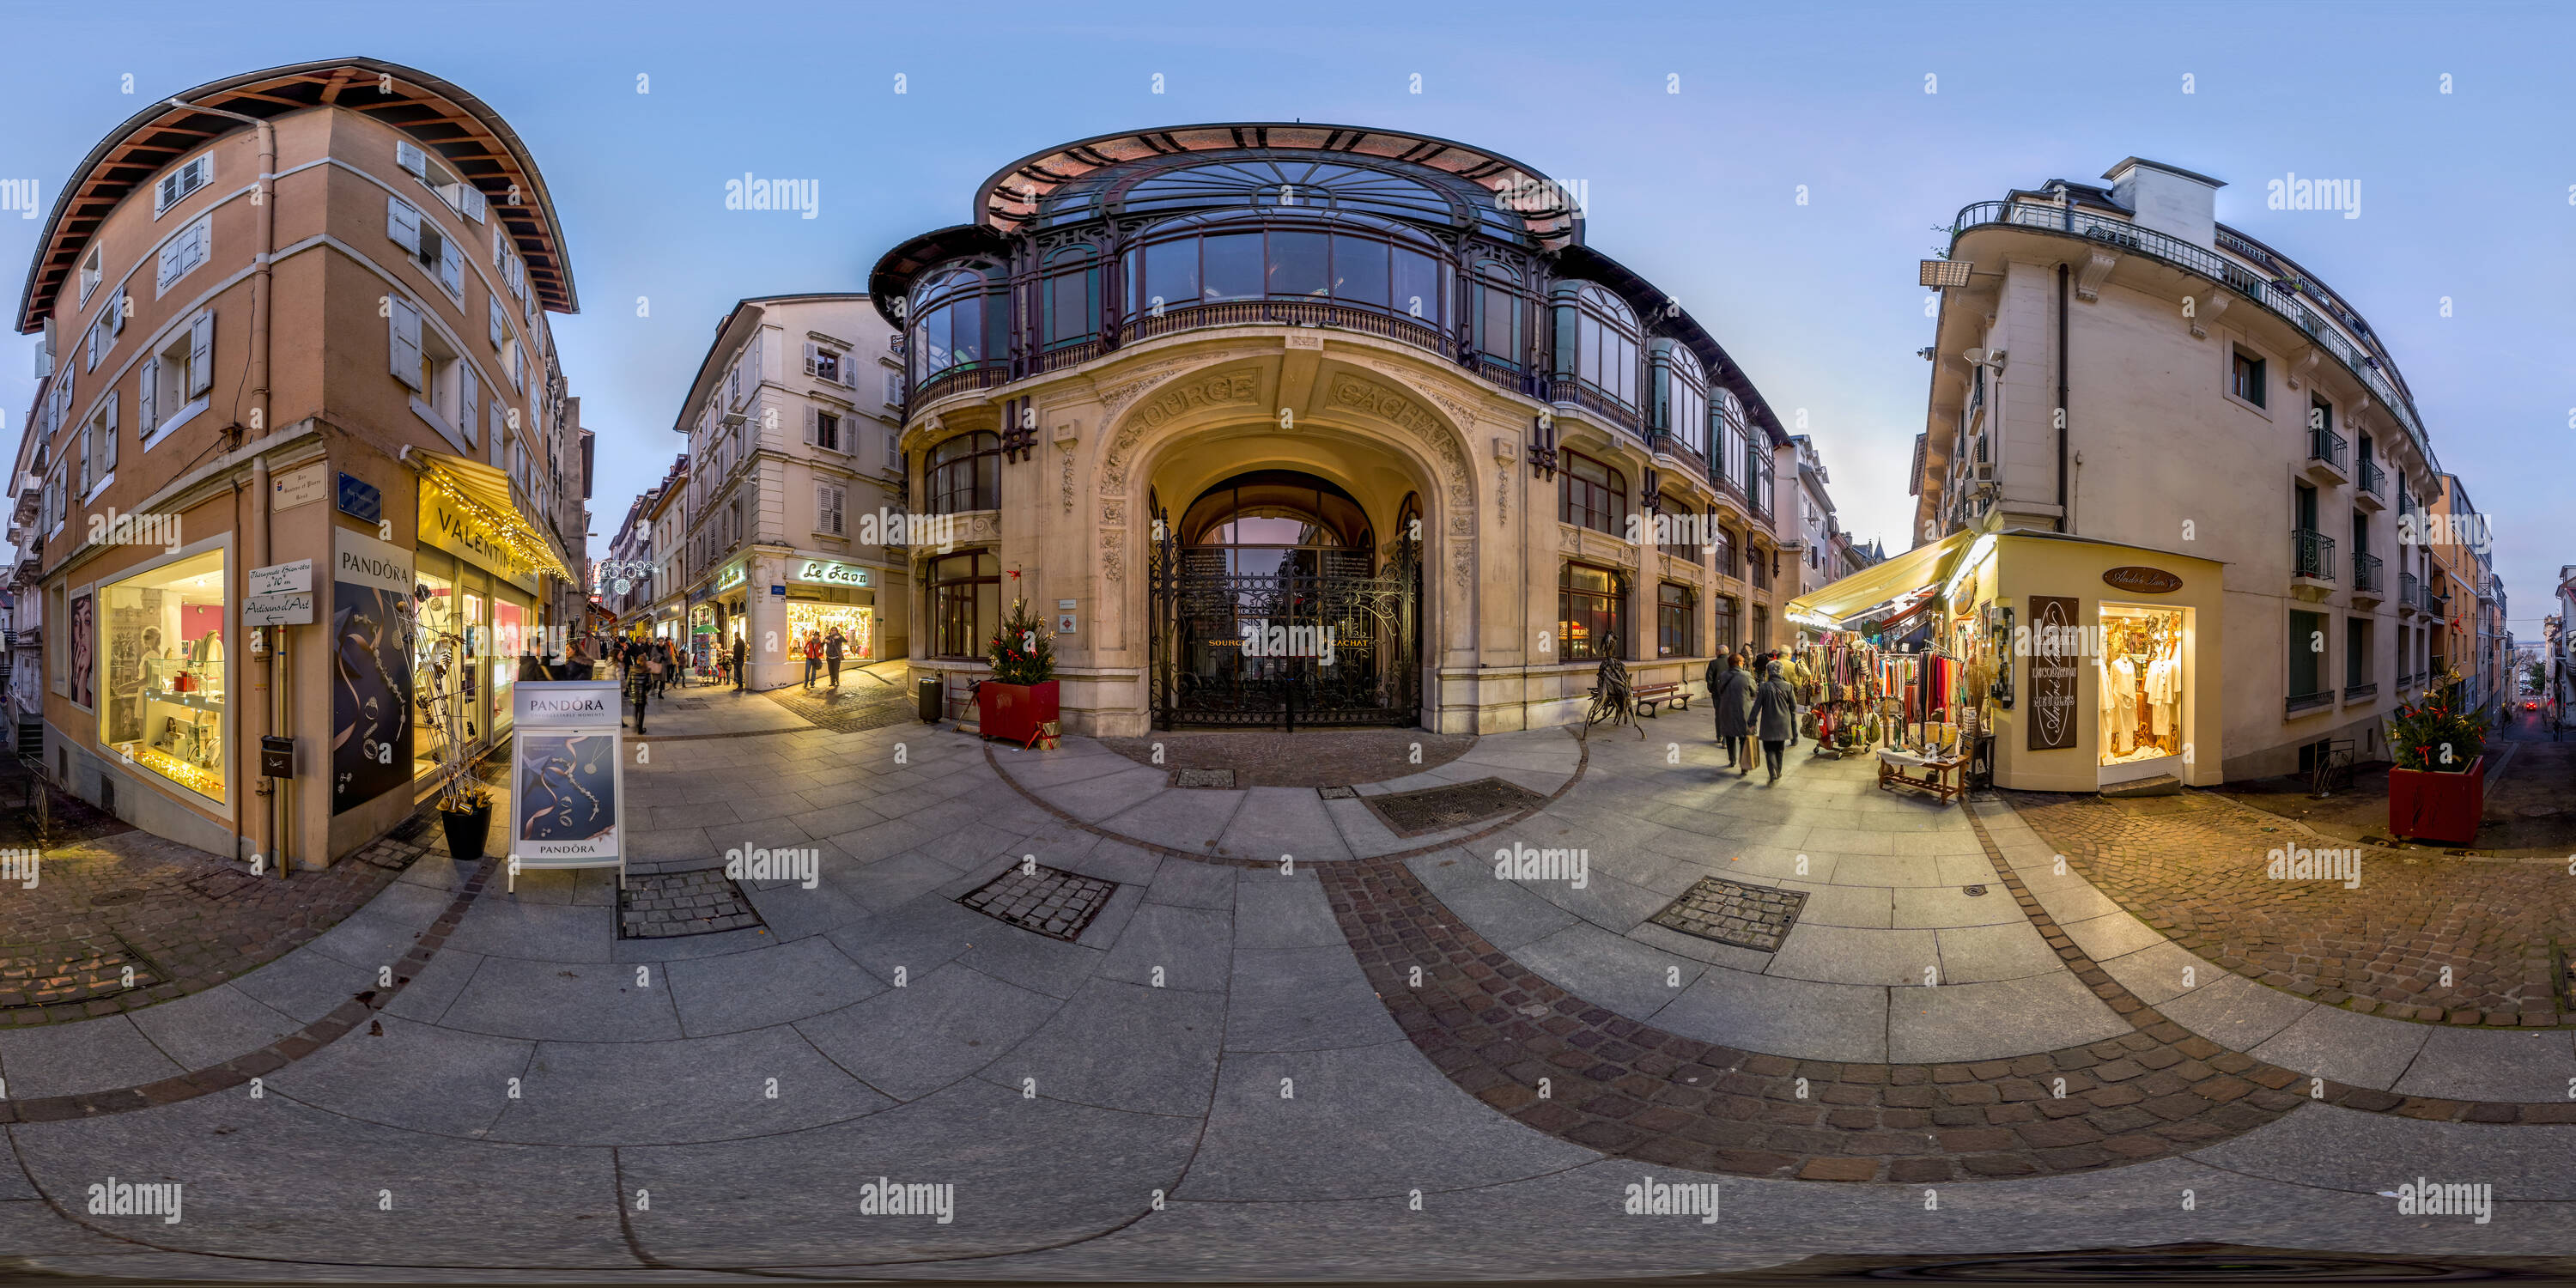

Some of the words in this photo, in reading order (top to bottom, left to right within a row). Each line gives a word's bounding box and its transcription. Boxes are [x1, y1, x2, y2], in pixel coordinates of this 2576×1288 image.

[1126, 375, 1252, 437] SOURCE
[1336, 382, 1457, 453] CACHAT
[438, 507, 516, 574] VALENTINE
[343, 550, 408, 584] PANDORA
[803, 562, 823, 578] Le
[828, 565, 867, 583] Faon
[274, 577, 283, 586] 10
[245, 601, 281, 615] Artisans
[531, 697, 605, 711] PANDORA
[540, 845, 595, 854] PANDORA
